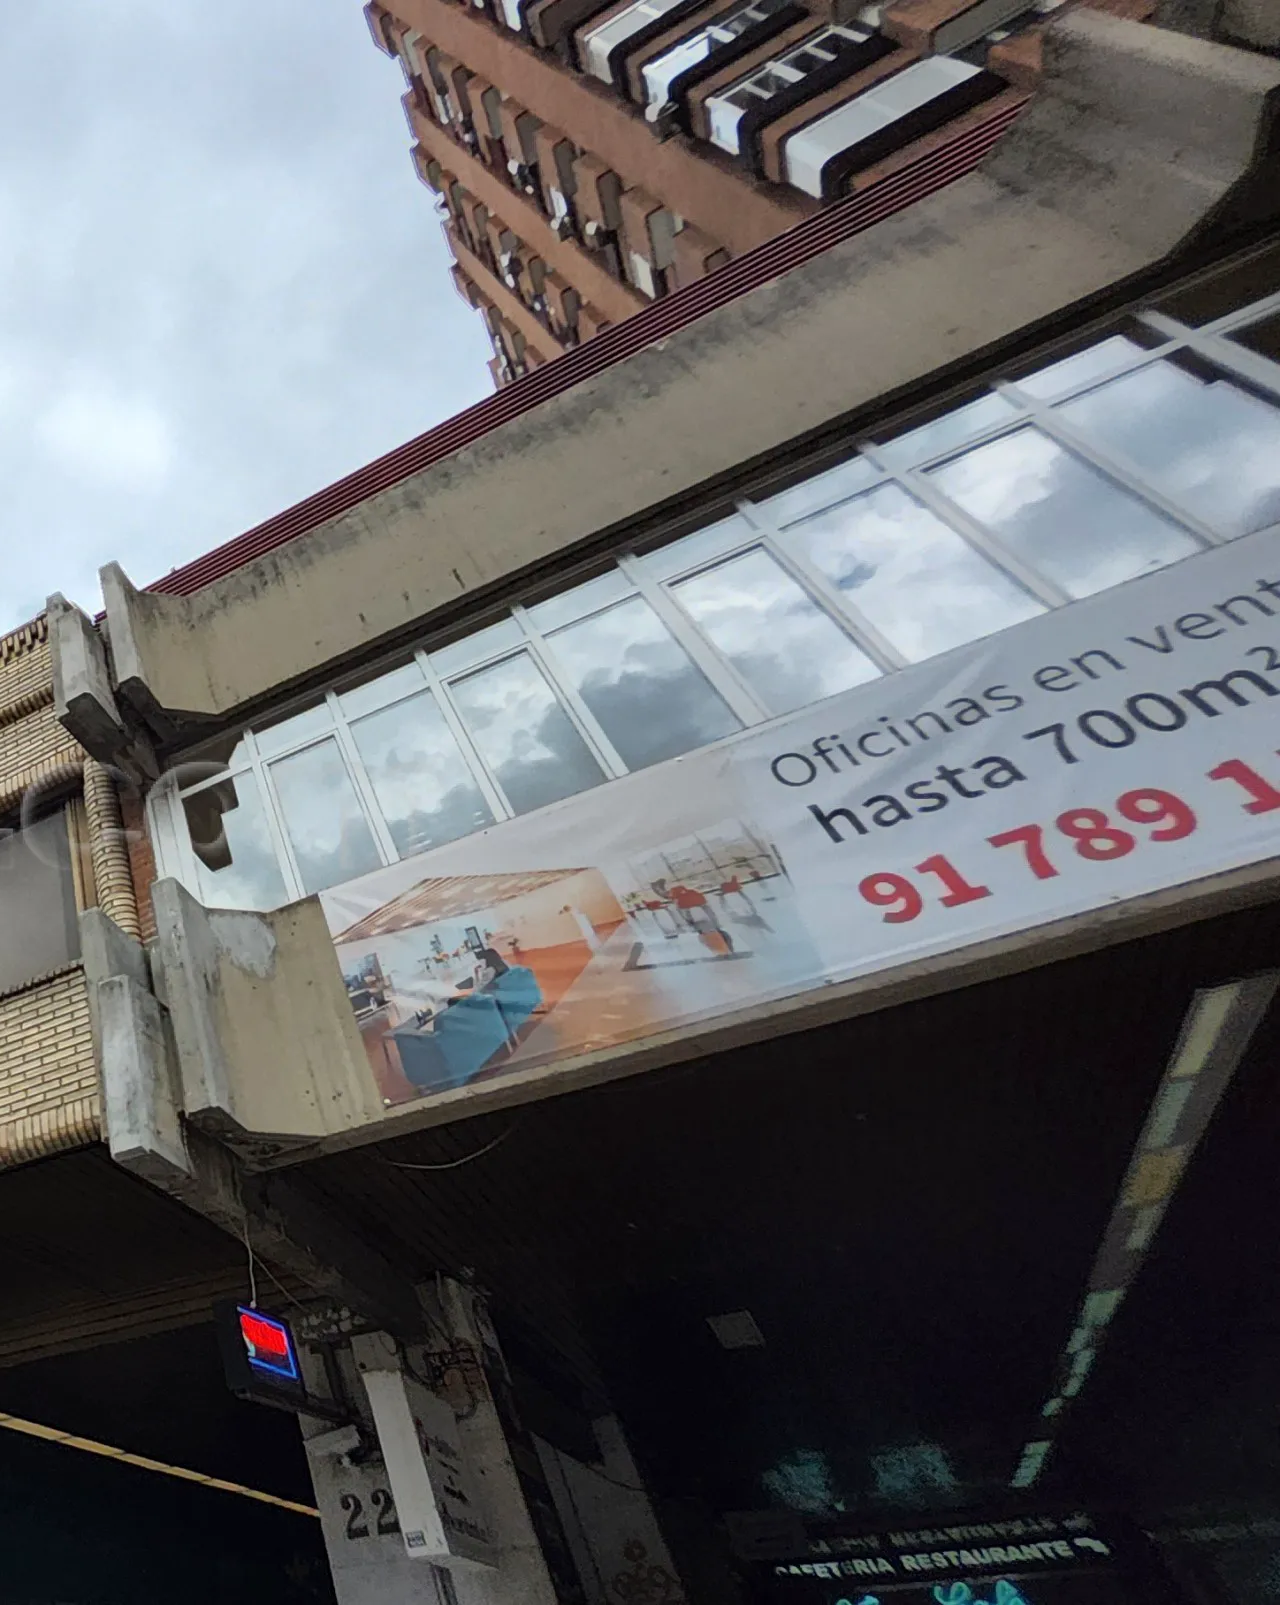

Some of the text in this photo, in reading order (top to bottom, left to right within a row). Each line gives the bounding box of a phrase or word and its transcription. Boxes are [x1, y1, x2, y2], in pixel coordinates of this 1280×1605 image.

[770, 683, 1024, 789] Oficinas
[1033, 648, 1127, 692] en
[808, 755, 1028, 844] hasta
[858, 853, 992, 925] 91
[986, 787, 1197, 880] 789
[898, 1539, 1075, 1573] RESTAURANTE
